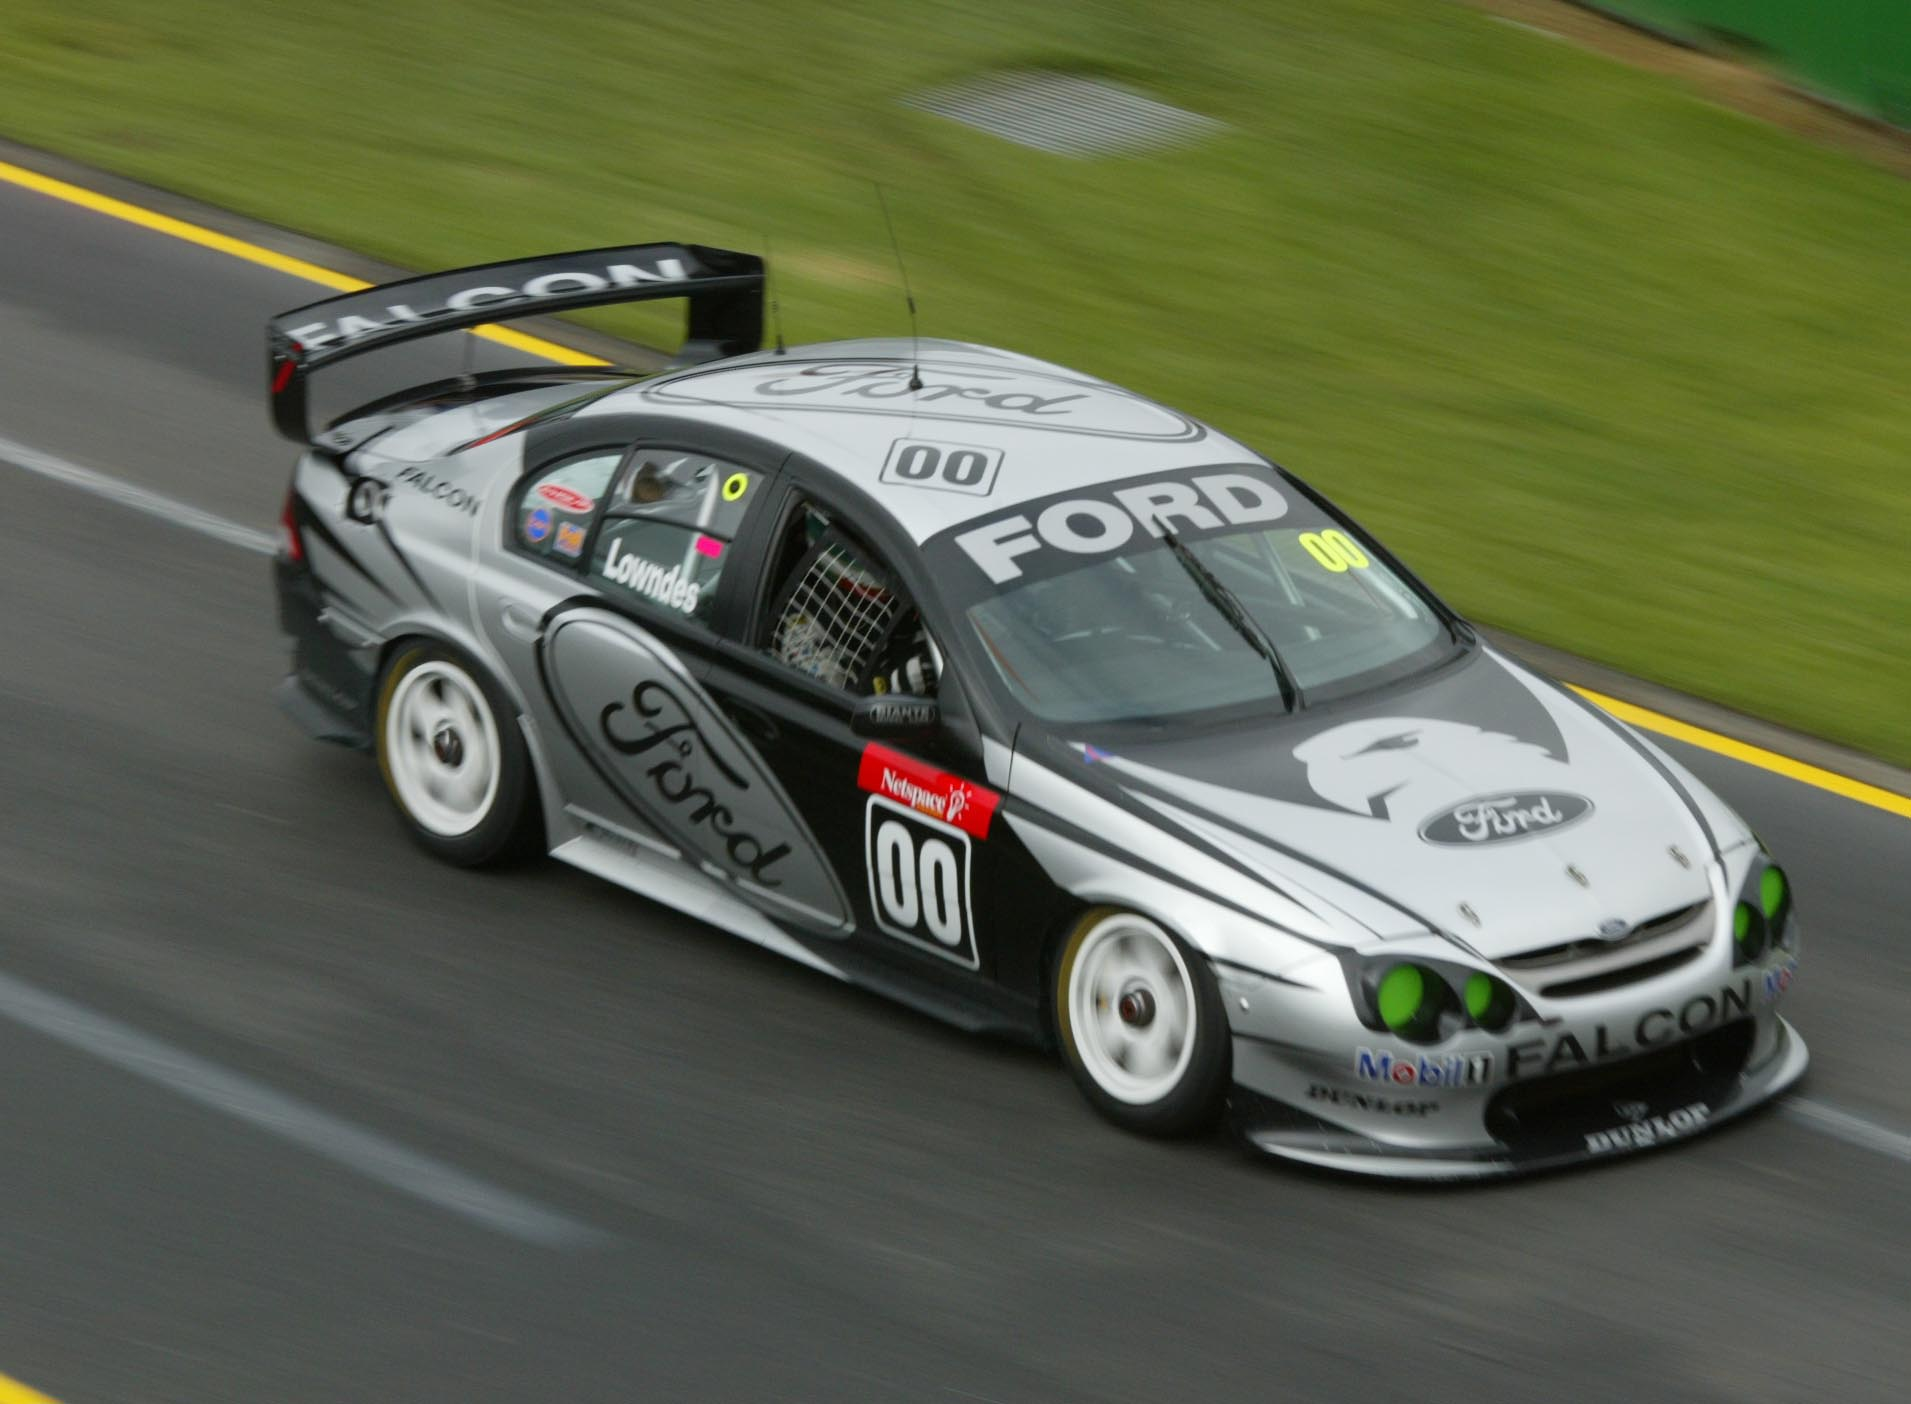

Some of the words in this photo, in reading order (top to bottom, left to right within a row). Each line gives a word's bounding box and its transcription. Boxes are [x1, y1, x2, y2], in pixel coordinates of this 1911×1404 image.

[283, 258, 688, 350] FALCON
[755, 363, 1090, 415] Ford
[397, 466, 481, 518] FALCON
[894, 445, 988, 487] 00
[955, 474, 1288, 584] FORD
[1299, 529, 1370, 572] 00
[602, 537, 700, 613] Lowndes
[600, 679, 792, 887] Ford
[881, 767, 946, 812] Netspace
[1454, 796, 1563, 842] Ford
[877, 820, 962, 946] 00
[1506, 979, 1753, 1076] FALCON
[1358, 1050, 1463, 1087] Mobil
[1307, 1083, 1440, 1118] DUNLOP
[1584, 1102, 1711, 1154] DUNLOP
